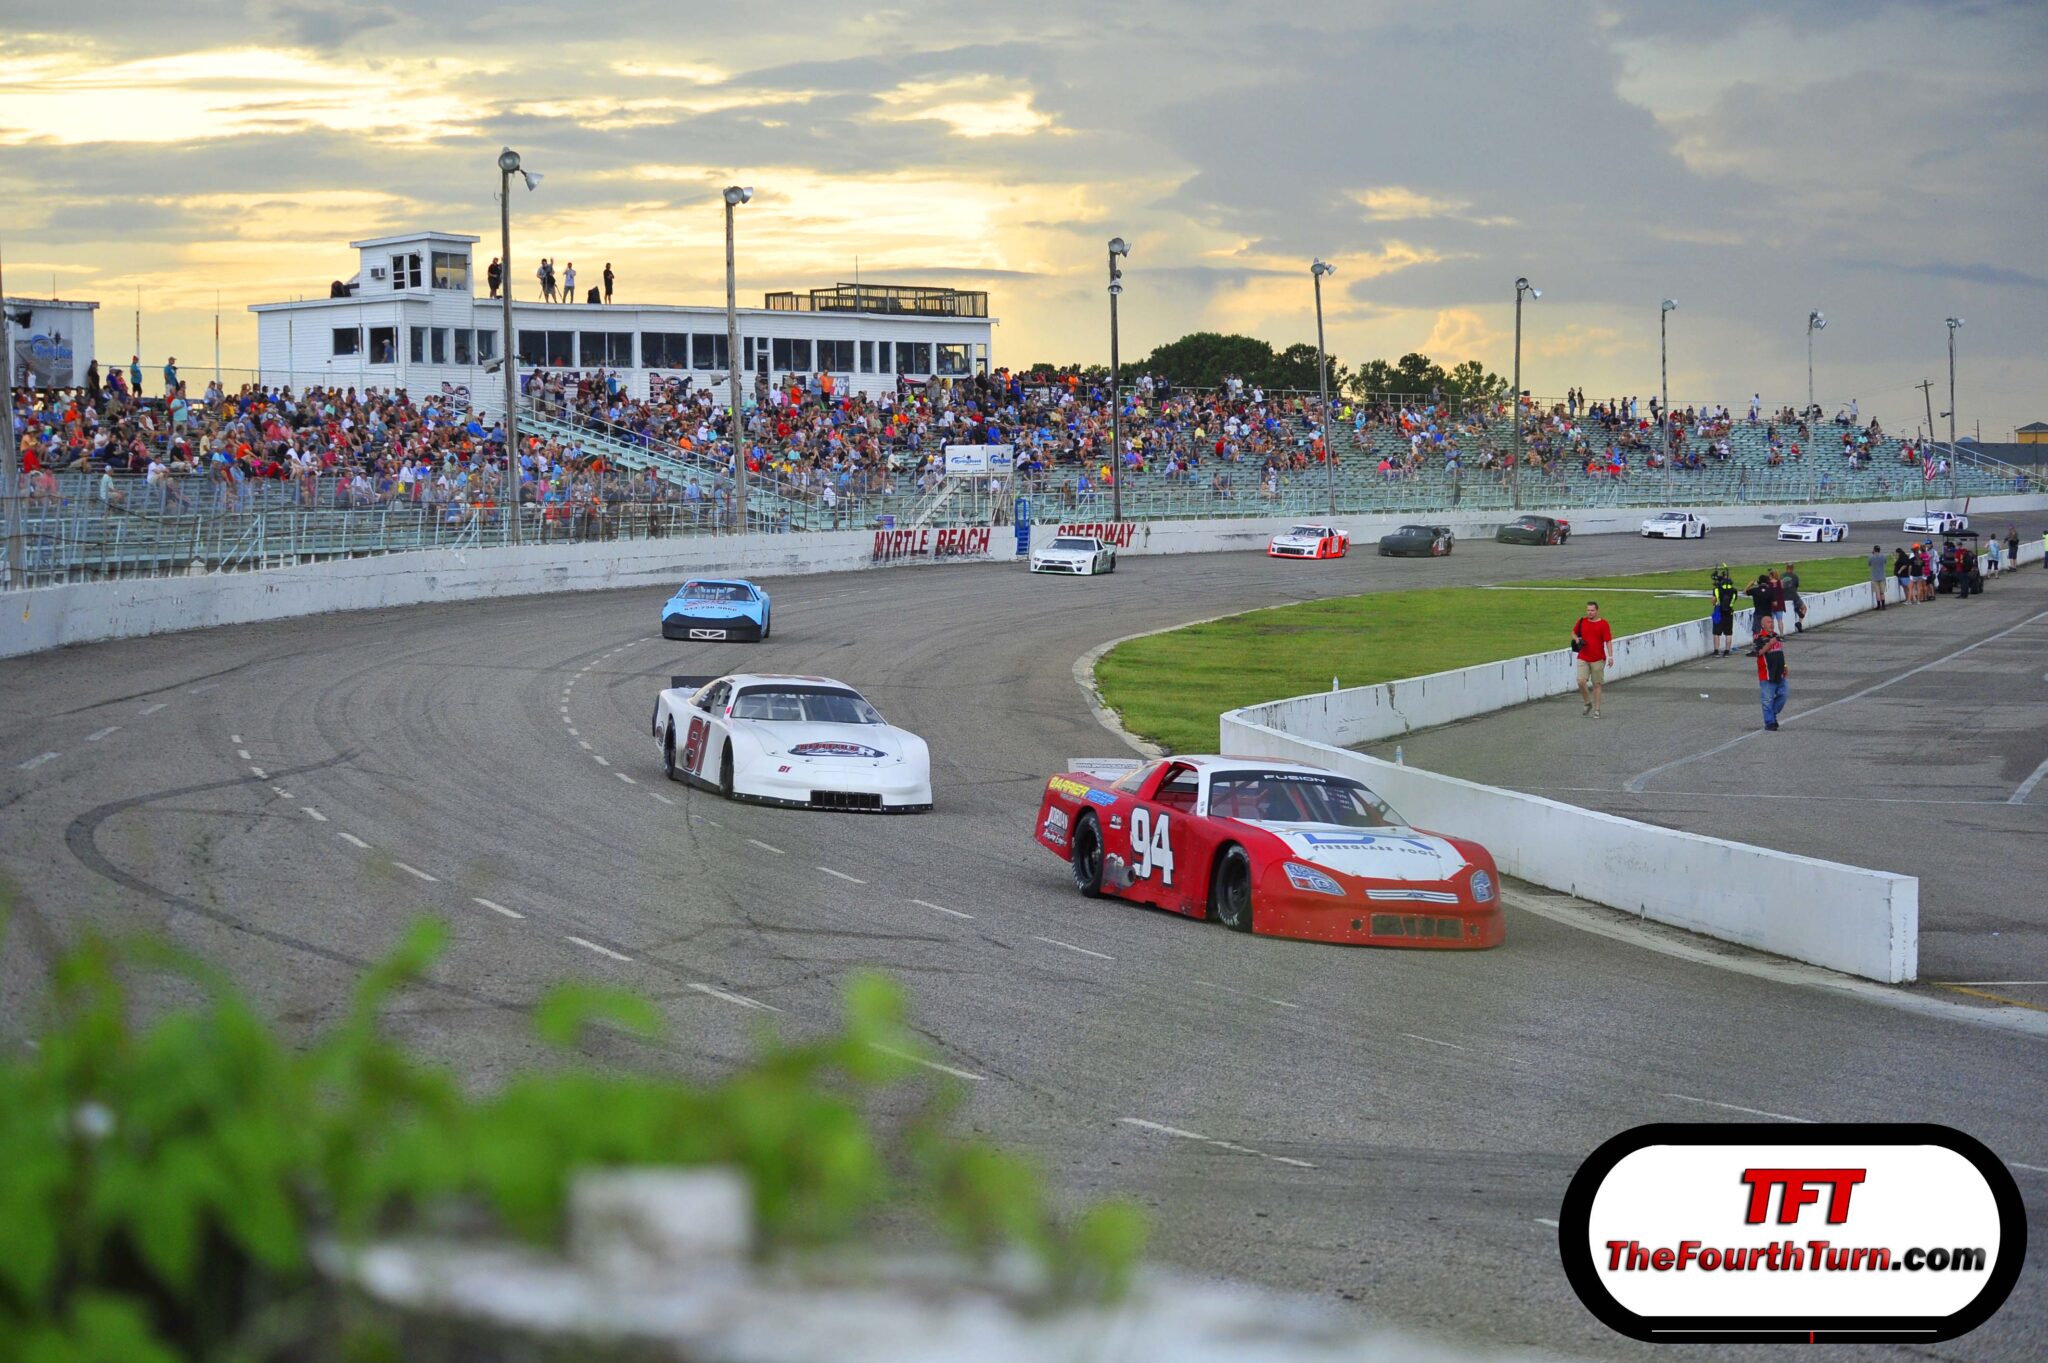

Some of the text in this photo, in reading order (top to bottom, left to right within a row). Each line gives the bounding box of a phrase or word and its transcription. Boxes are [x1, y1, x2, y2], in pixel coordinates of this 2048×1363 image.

[873, 530, 928, 561] MYRTLE
[935, 528, 991, 556] BEACH
[683, 715, 711, 776] 81
[1048, 776, 1091, 798] BARRIER
[1263, 774, 1327, 783] FUSION
[1130, 805, 1174, 885] 94
